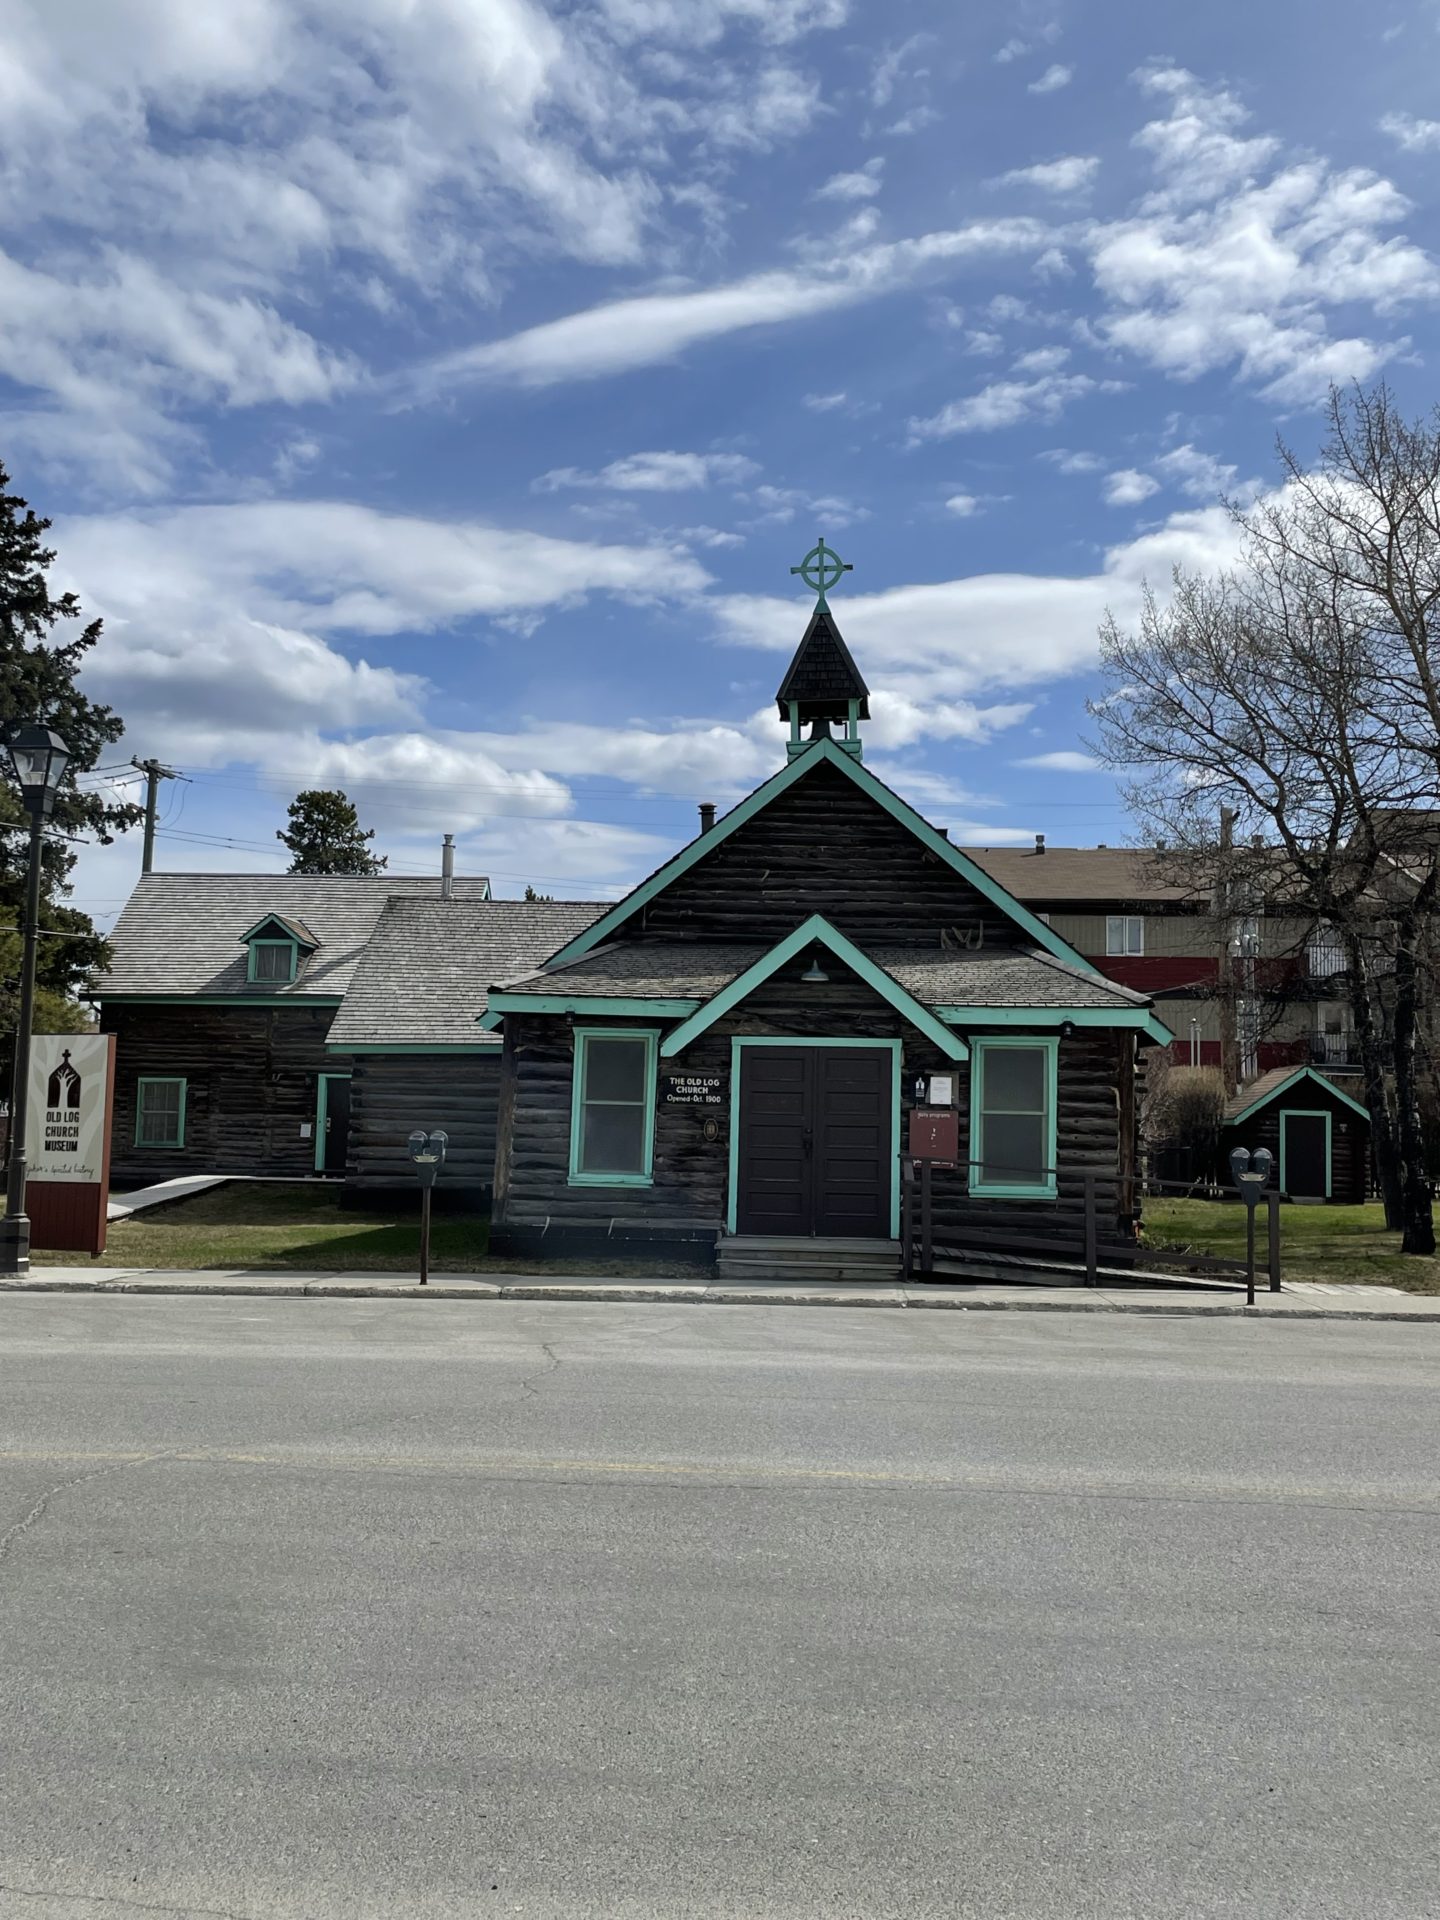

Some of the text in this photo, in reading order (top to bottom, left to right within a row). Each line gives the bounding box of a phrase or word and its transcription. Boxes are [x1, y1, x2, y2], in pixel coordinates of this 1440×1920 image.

[669, 1077, 720, 1087] THE OLD LOG
[676, 1086, 709, 1094] CHURCH
[705, 1095, 721, 1103] 1900
[46, 1111, 80, 1123] OLD LOG
[45, 1126, 79, 1138] CHURCH
[44, 1140, 78, 1152] MUSEUM
